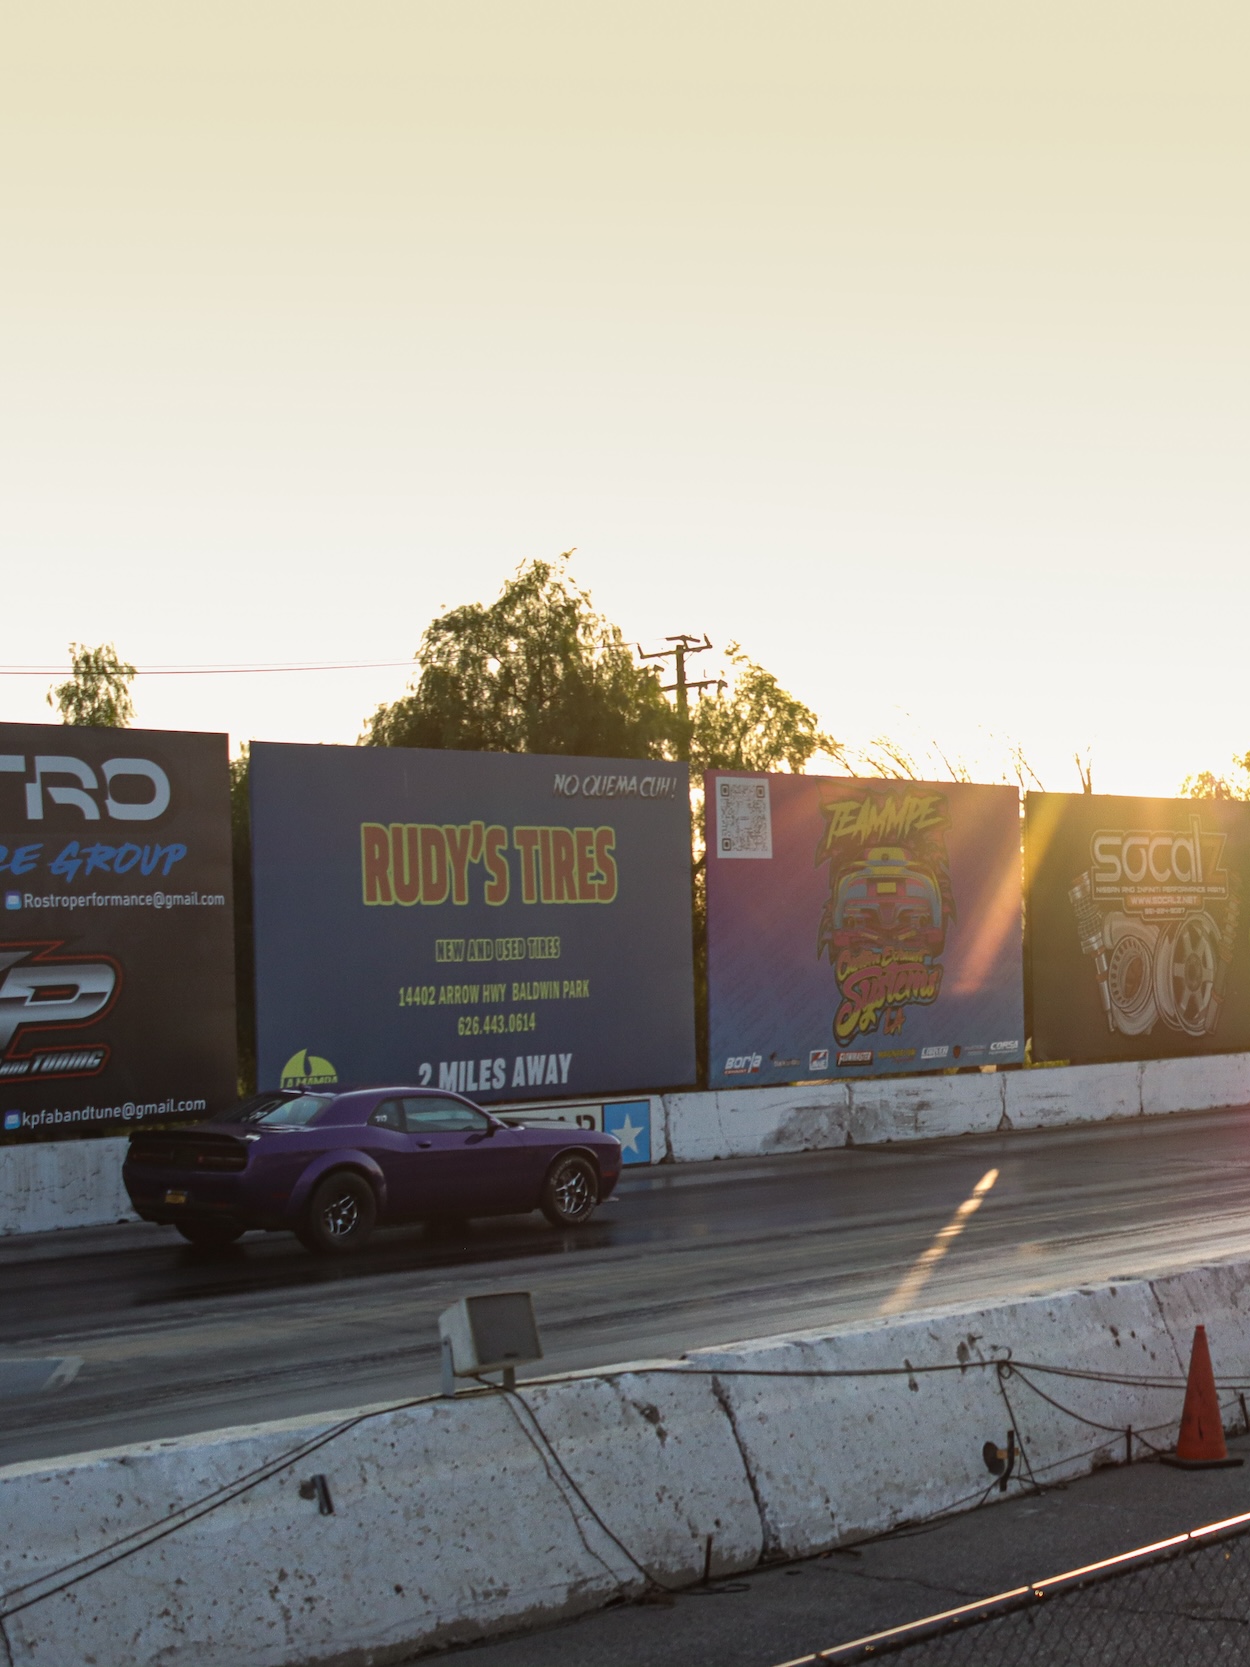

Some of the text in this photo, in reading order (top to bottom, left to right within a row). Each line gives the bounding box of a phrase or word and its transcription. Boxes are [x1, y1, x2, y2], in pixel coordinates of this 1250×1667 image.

[553, 774, 580, 796] NO
[582, 774, 637, 797] QUEMA
[49, 841, 187, 884] GROUP
[361, 821, 618, 906] RUDY'S TIRES
[23, 892, 225, 910] Rostroperformance@gmail.com
[436, 936, 561, 962] NEW AND USED TIRES
[398, 979, 590, 1007] 14402 ARROW HWY BALDWIN PARK
[457, 1011, 537, 1036] 626.443.0614
[418, 1053, 574, 1093] 2 MILES AWAY
[22, 1098, 206, 1129] kpfabandtune@gmail.com
